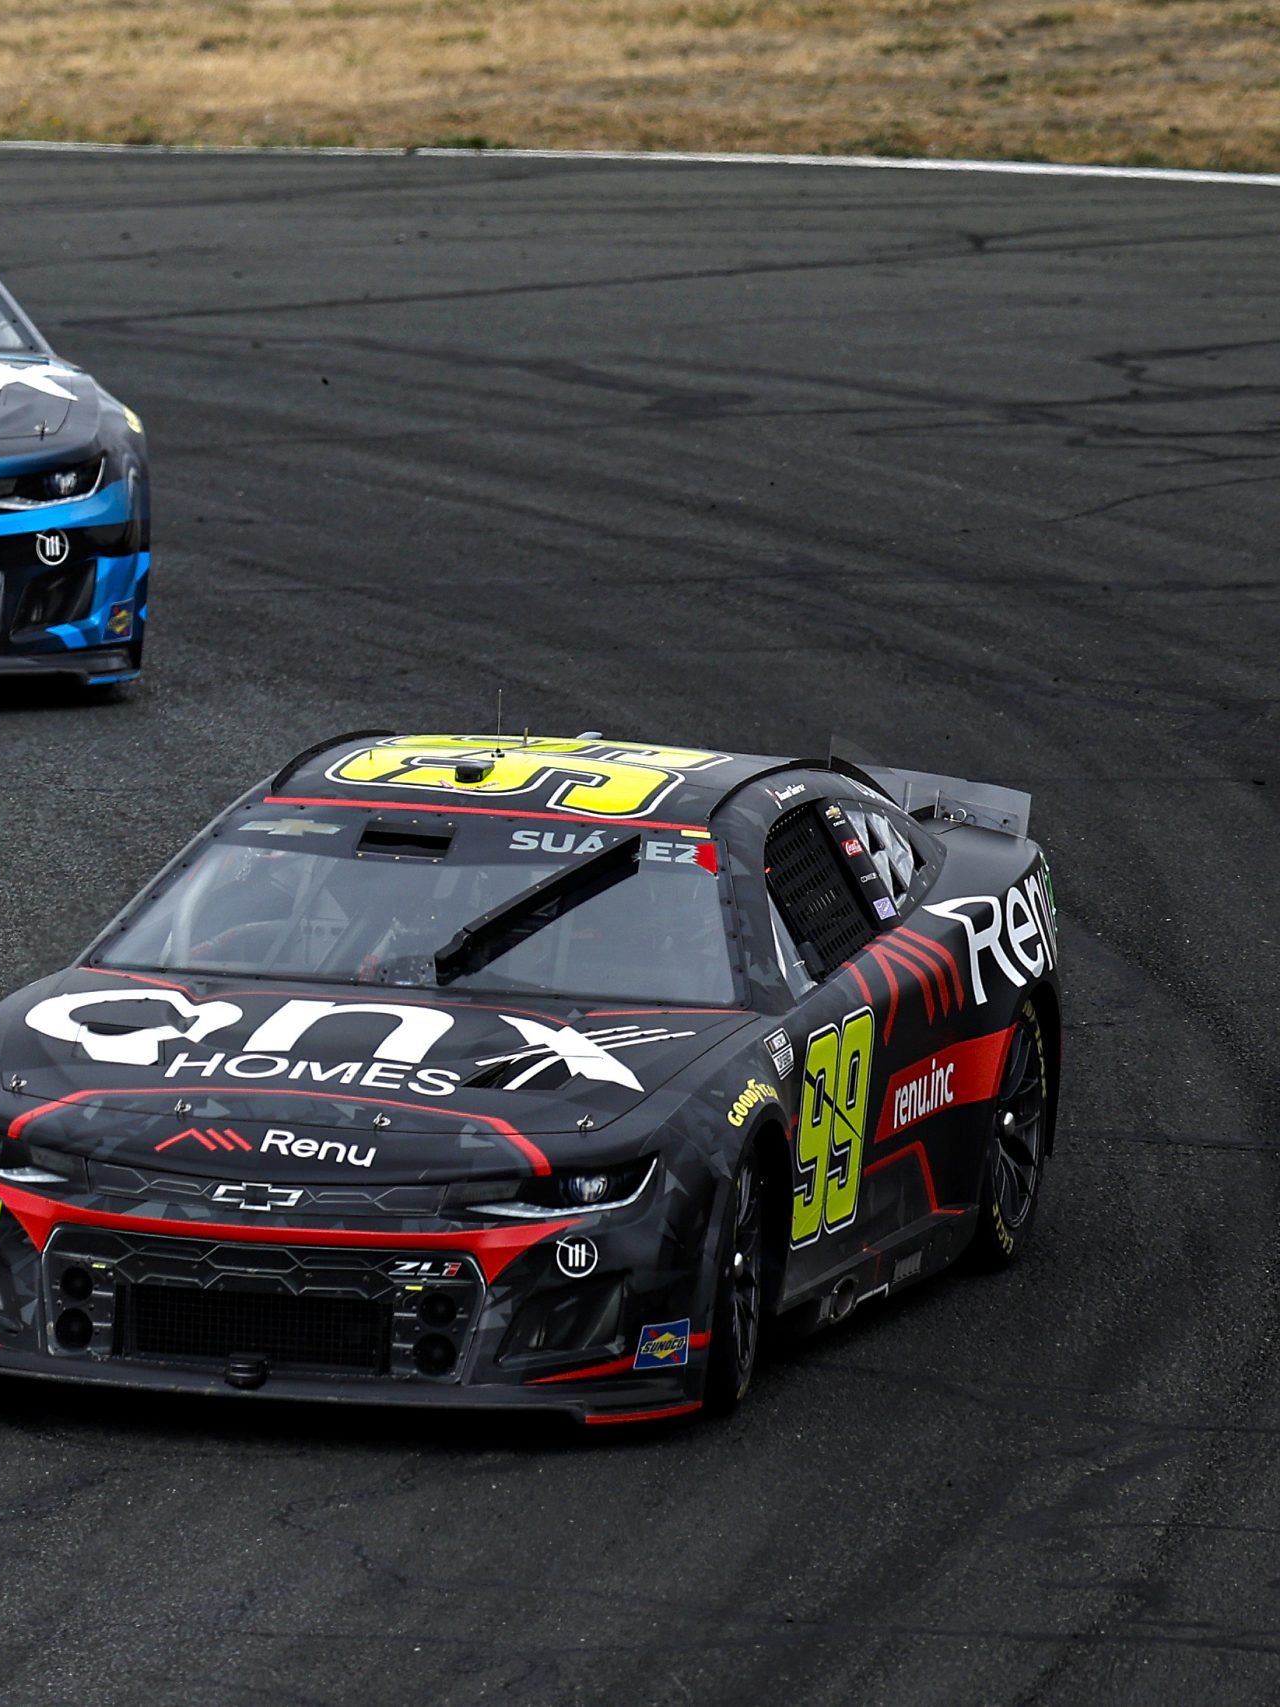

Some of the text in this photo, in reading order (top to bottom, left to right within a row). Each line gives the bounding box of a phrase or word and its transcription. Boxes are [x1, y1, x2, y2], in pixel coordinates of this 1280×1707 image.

[508, 830, 699, 865] SUÁEZ
[163, 1052, 462, 1097] HOMES
[892, 1058, 955, 1129] renu.inc
[260, 1128, 377, 1168] Renu
[790, 1005, 875, 1251] 99
[387, 1261, 462, 1278] ZL1
[641, 1336, 688, 1355] SUNOCO
